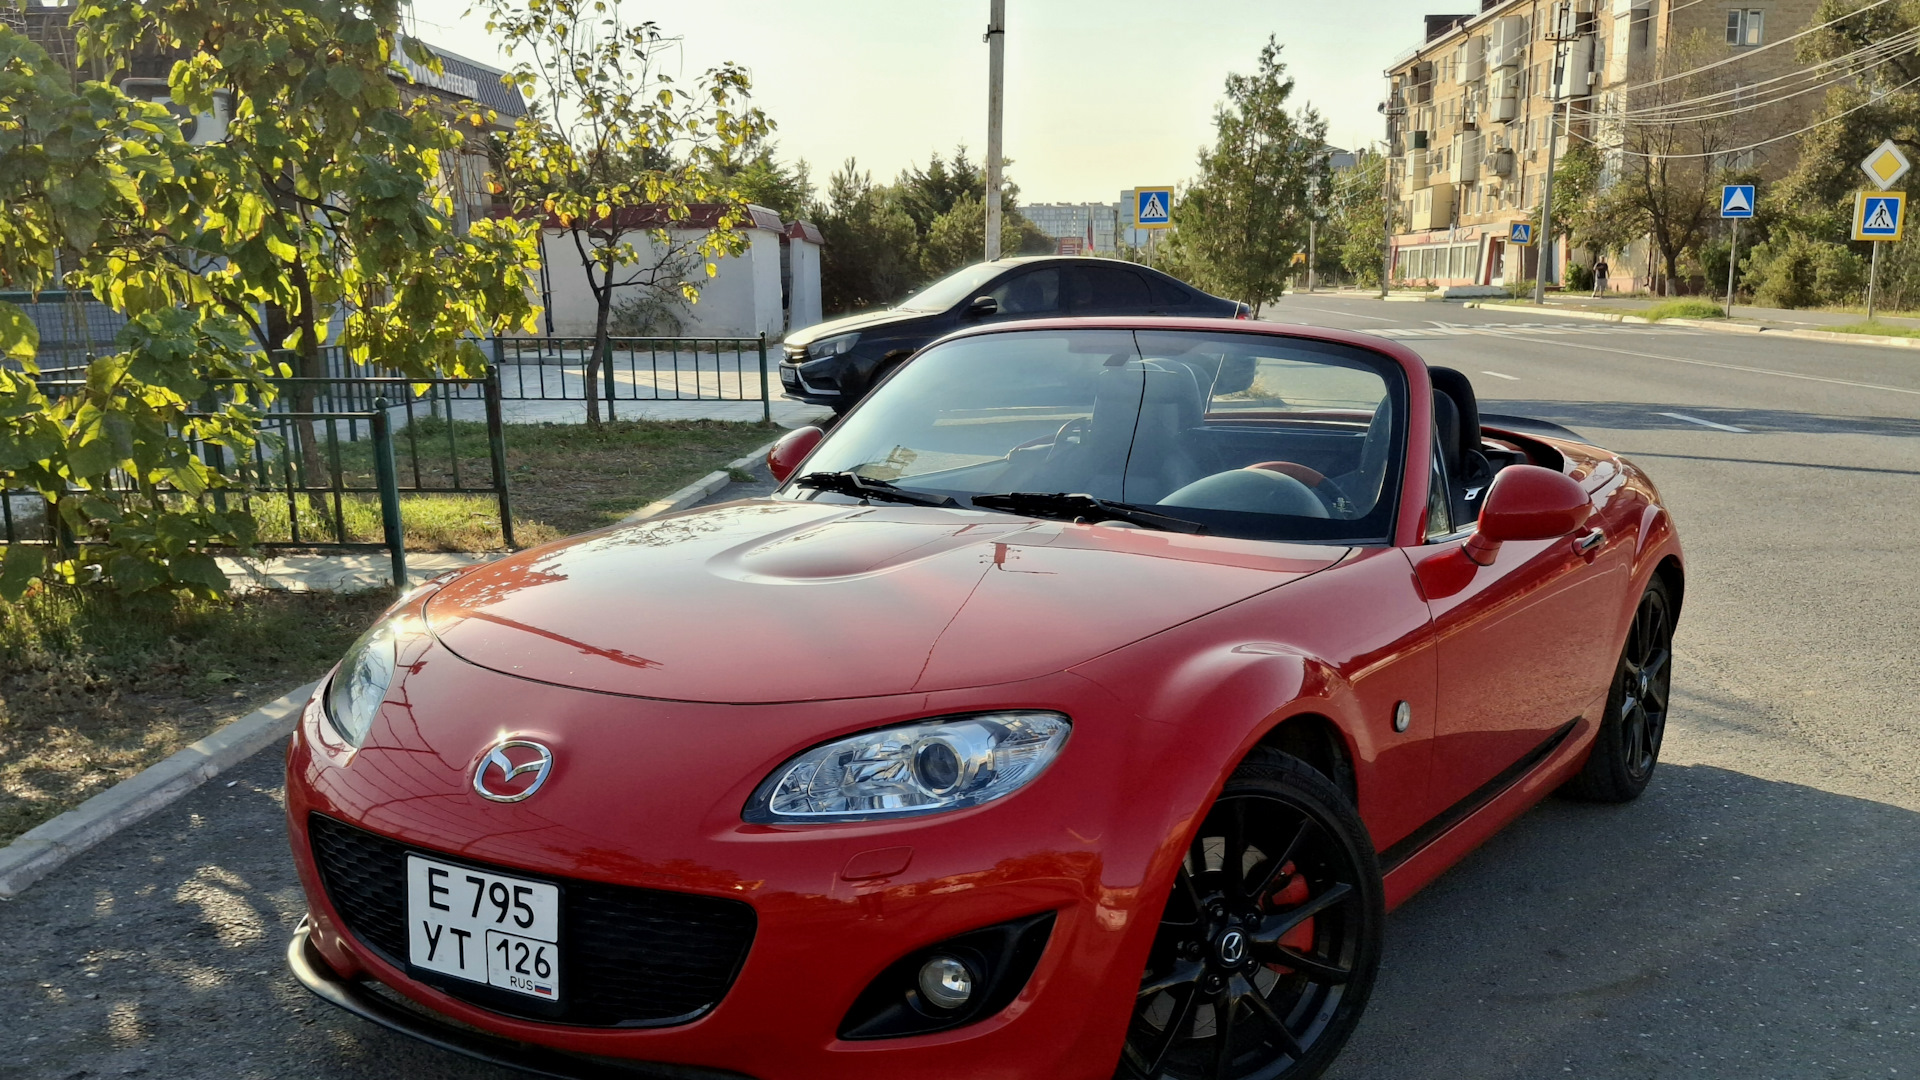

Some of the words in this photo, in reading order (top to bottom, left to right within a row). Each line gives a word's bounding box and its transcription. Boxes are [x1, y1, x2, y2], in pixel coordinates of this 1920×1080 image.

[437, 71, 463, 94] COFFEE
[463, 77, 478, 99] BAR
[465, 875, 535, 929] 795
[496, 938, 552, 979] 126
[510, 975, 534, 991] RUS
